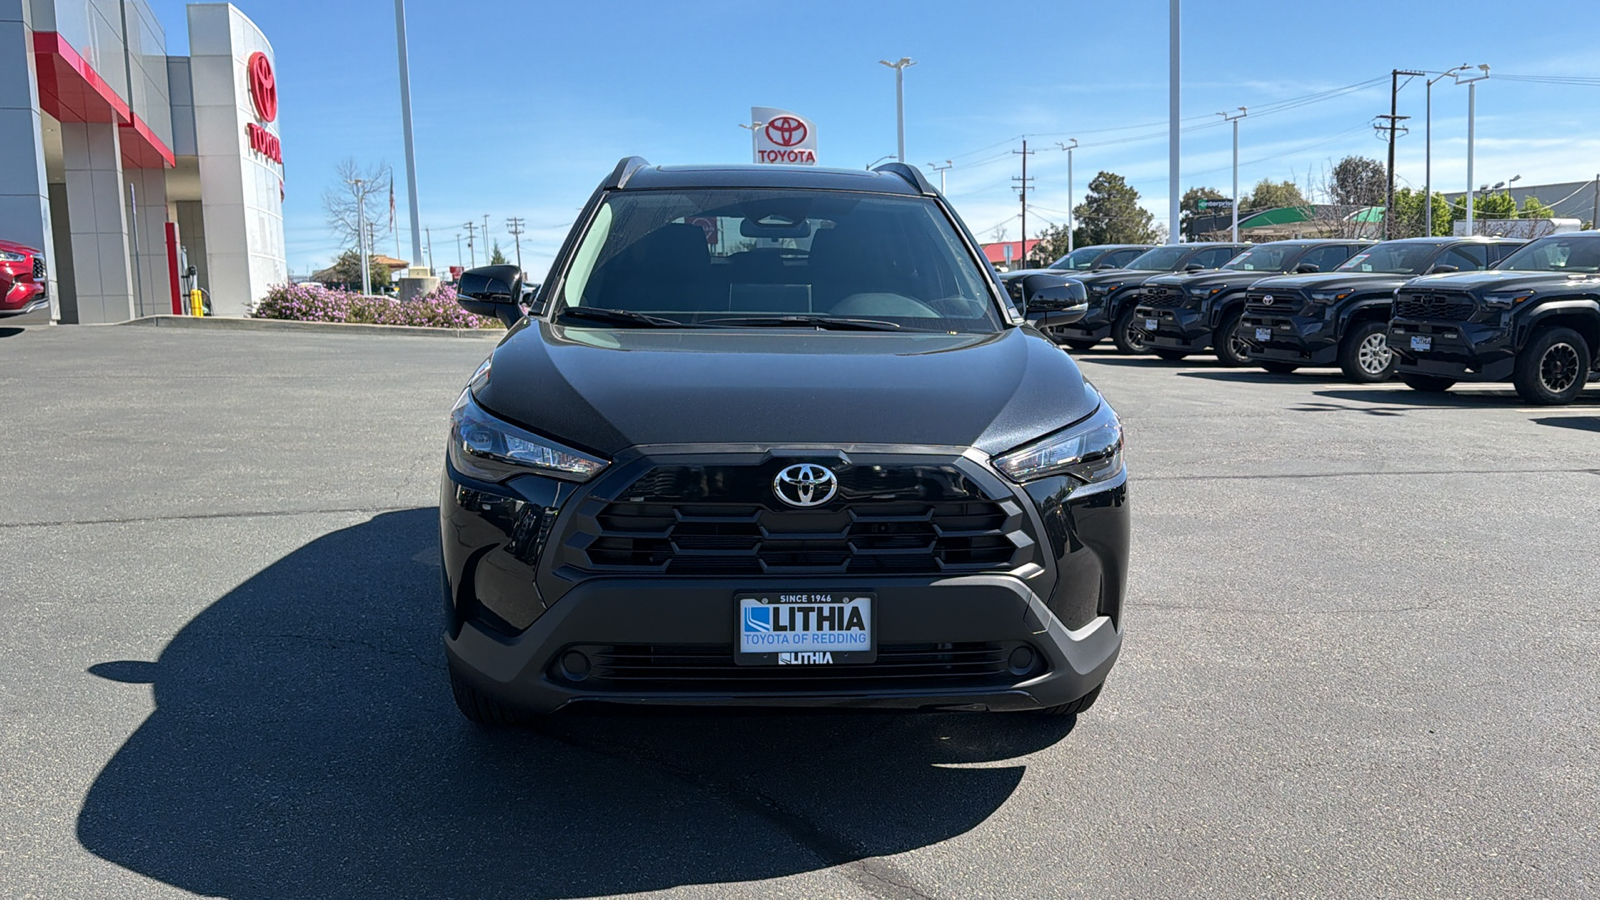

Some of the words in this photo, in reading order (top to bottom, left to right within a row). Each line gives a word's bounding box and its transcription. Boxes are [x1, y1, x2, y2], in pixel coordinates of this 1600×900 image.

[247, 123, 282, 164] TOYOT
[758, 150, 815, 163] TOYOTA
[780, 594, 807, 602] SINCE
[811, 594, 832, 602] 1946
[773, 606, 866, 631] LITHIA
[744, 634, 789, 645] TOYOTA
[793, 633, 808, 644] OF
[812, 633, 866, 644] REDDING
[791, 652, 833, 664] LITHIA
